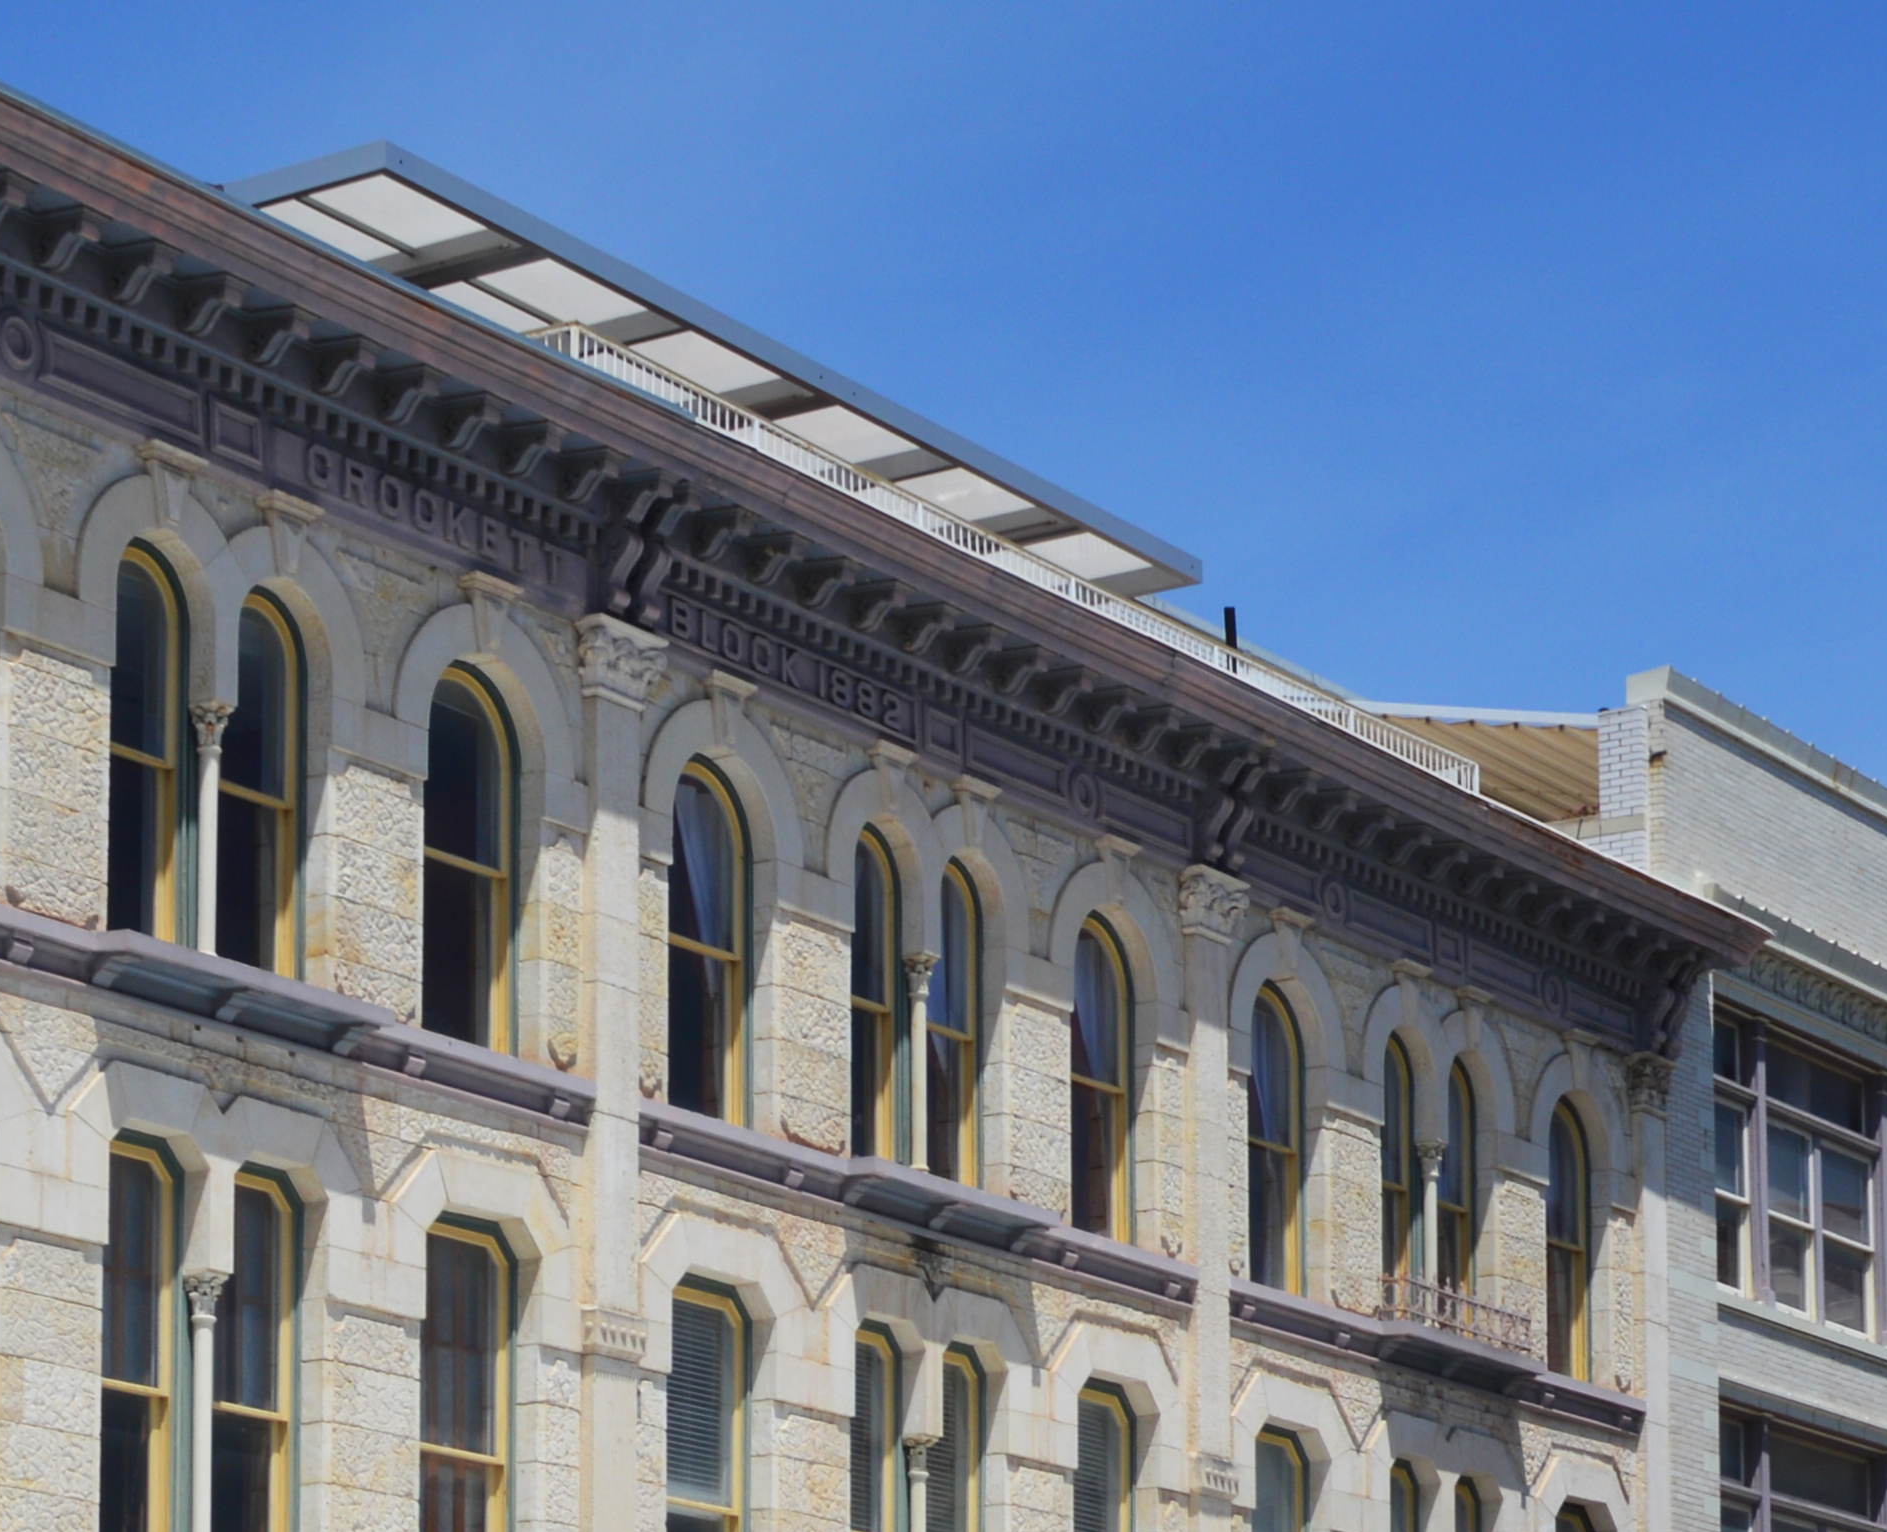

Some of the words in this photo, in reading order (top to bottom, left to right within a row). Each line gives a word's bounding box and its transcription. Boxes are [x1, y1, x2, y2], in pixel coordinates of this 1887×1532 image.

[306, 444, 562, 586] CROCKETT
[671, 598, 800, 690] BLOCK
[819, 657, 904, 731] 1882
